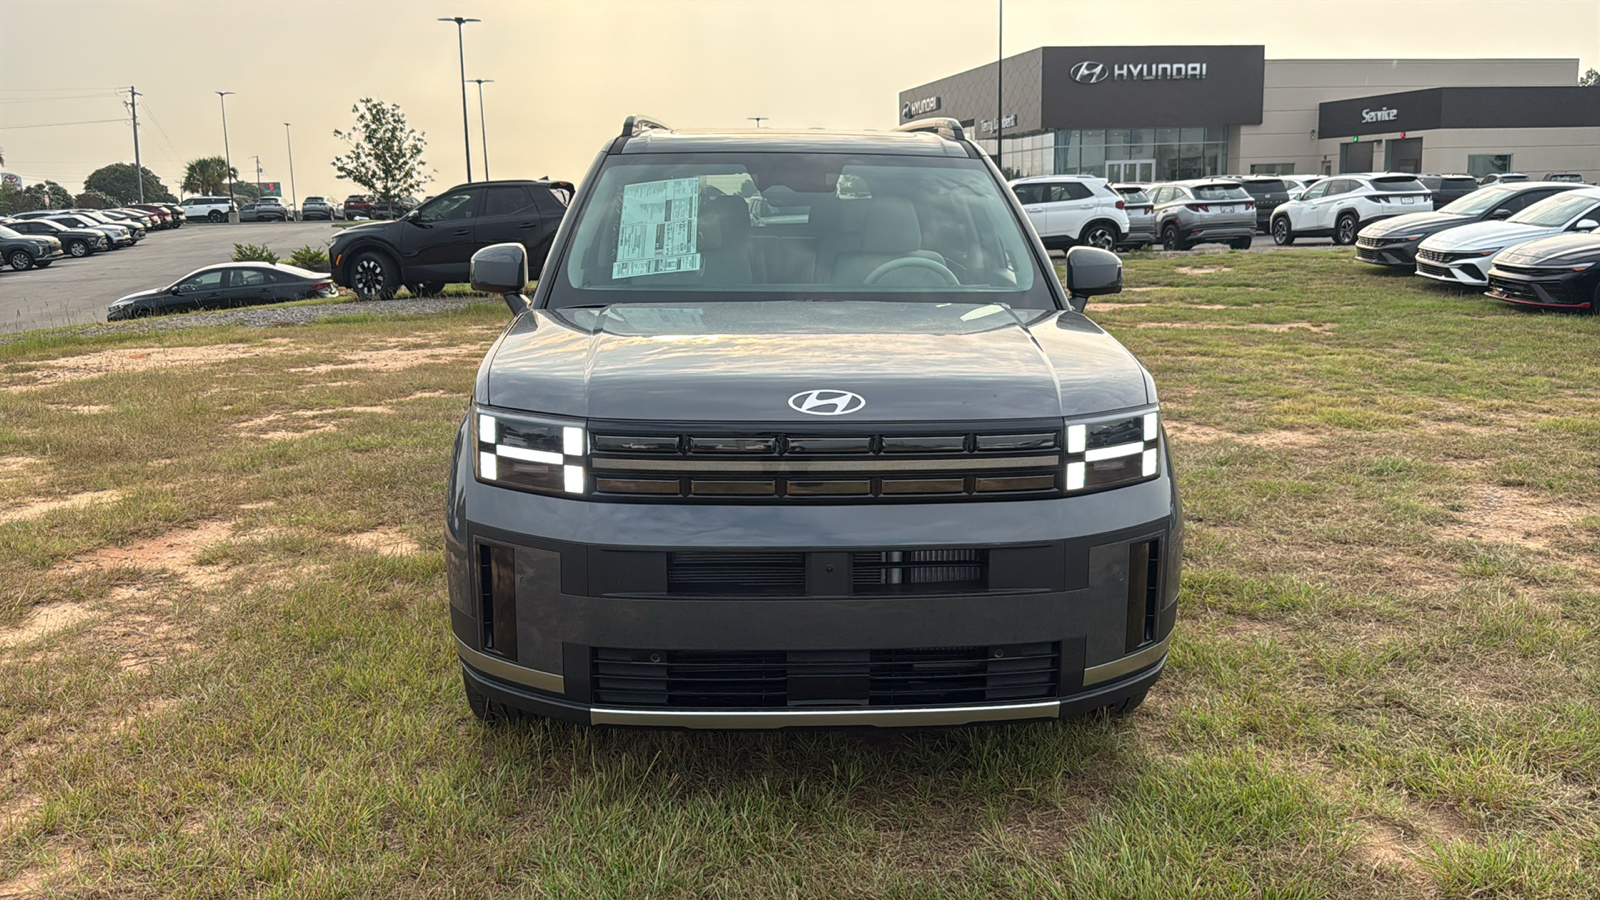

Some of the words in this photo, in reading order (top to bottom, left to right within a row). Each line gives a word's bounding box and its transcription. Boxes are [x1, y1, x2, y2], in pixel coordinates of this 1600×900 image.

[1113, 62, 1207, 80] HYUNDAI
[911, 96, 937, 116] HYUNDAI
[1361, 106, 1398, 124] Service
[980, 119, 994, 134] Terry
